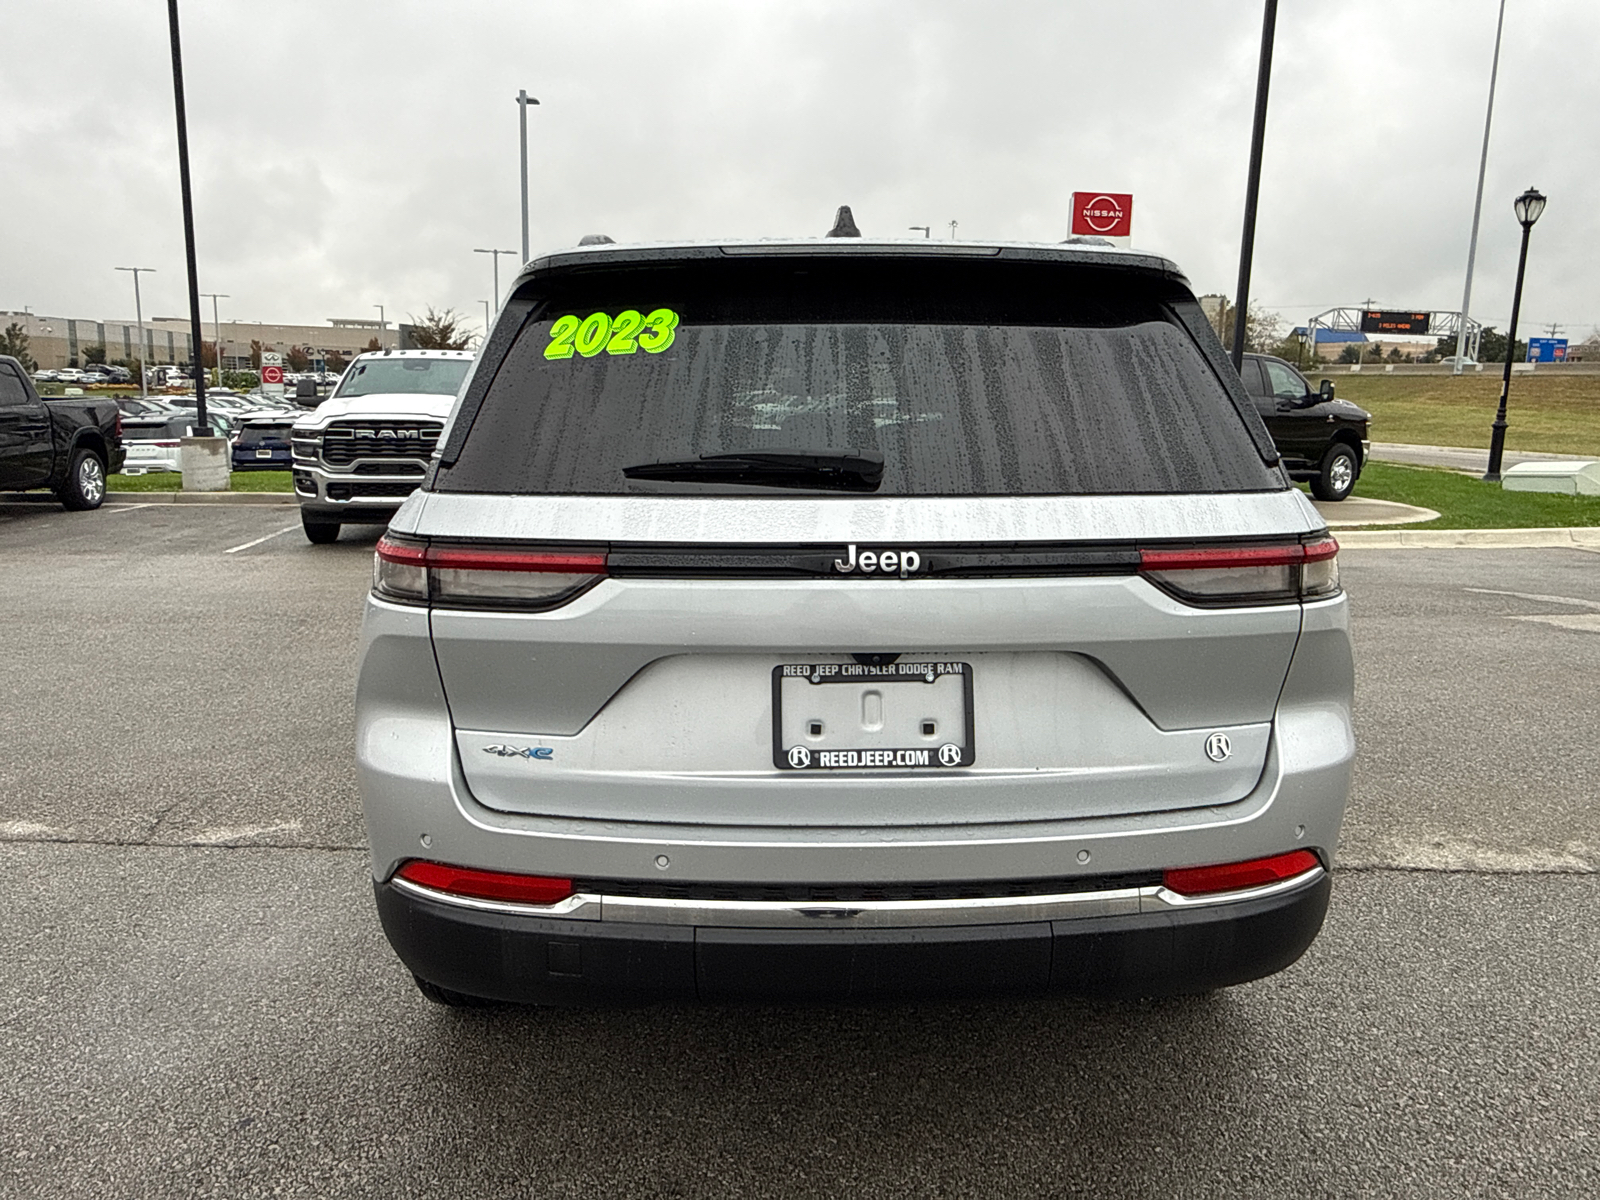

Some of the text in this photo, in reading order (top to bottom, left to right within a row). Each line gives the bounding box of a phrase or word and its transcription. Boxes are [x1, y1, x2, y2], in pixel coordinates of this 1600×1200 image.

[1083, 209, 1123, 218] NISSAN
[543, 308, 680, 361] 2023
[355, 429, 419, 439] RAM
[834, 544, 921, 579] Jeep
[782, 662, 963, 677] REED JEEP CHRYSLER DODGE RAM
[819, 749, 929, 767] REEDJEEP.COM
